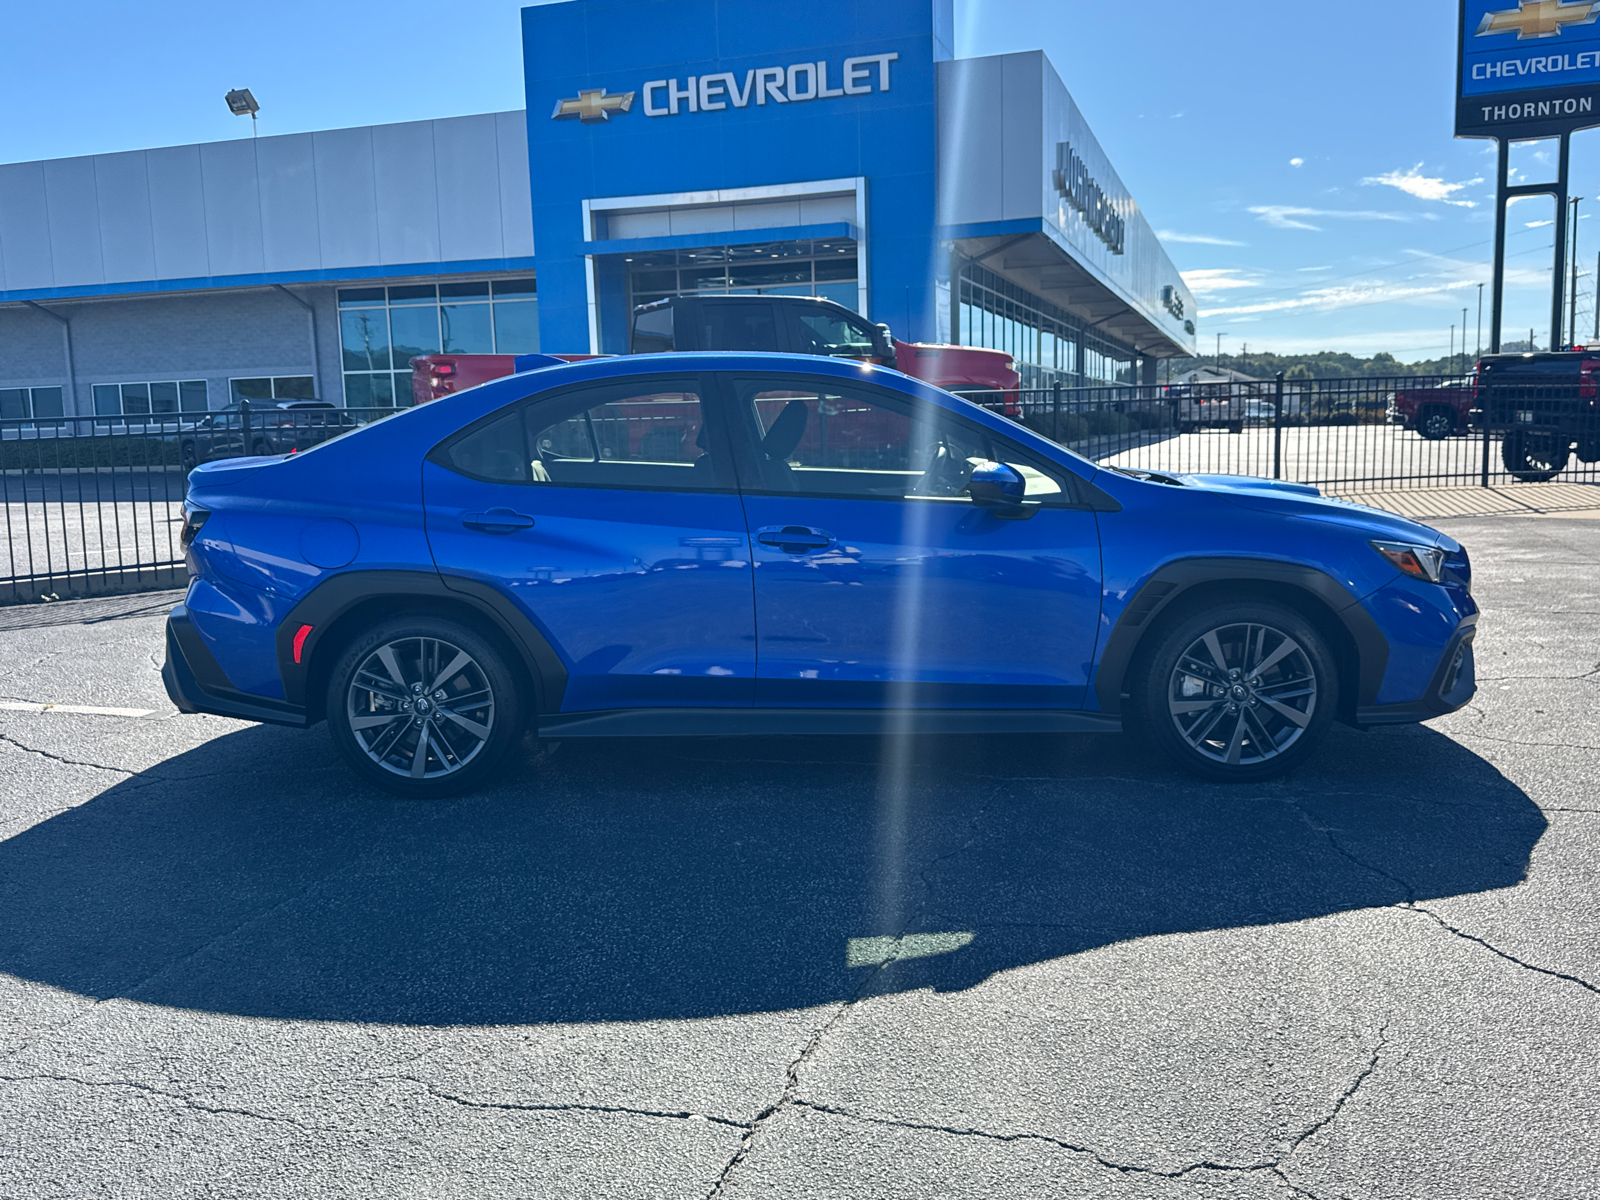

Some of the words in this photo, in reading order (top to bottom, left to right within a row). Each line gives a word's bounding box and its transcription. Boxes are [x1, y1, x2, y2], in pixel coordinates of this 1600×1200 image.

[1471, 50, 1600, 80] CHEVROLET
[642, 52, 899, 117] CHEVROLET
[1481, 96, 1593, 121] THORNTON
